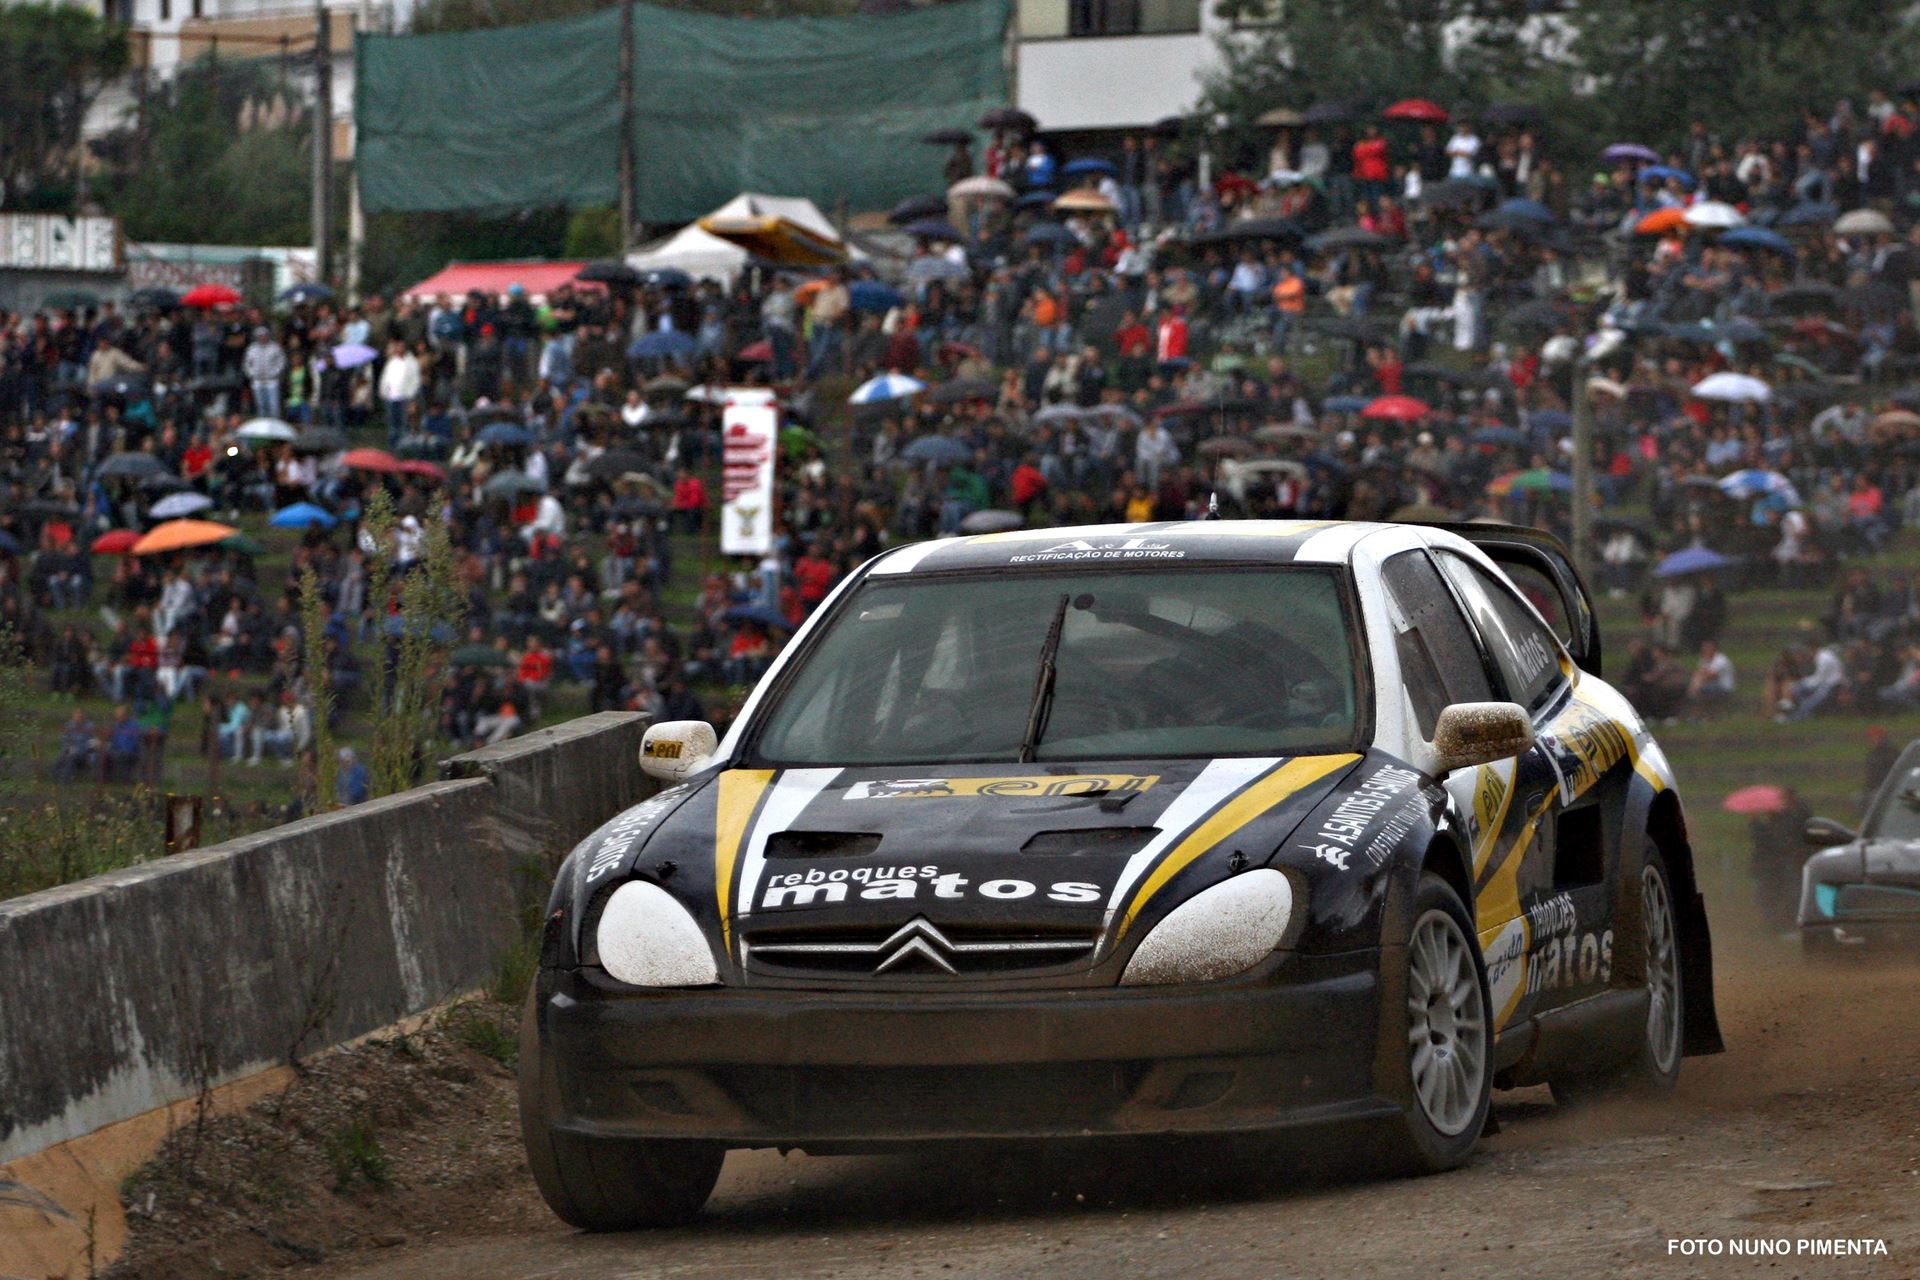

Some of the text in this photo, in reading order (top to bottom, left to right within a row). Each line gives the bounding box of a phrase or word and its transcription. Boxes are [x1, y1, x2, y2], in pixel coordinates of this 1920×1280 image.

[1010, 550, 1186, 563] RECTIFICAÇÃO DE MOTORES
[656, 741, 684, 759] eni
[976, 777, 1145, 798] eni
[769, 865, 939, 889] reboques
[761, 873, 1101, 907] matos
[1526, 920, 1614, 995] matos
